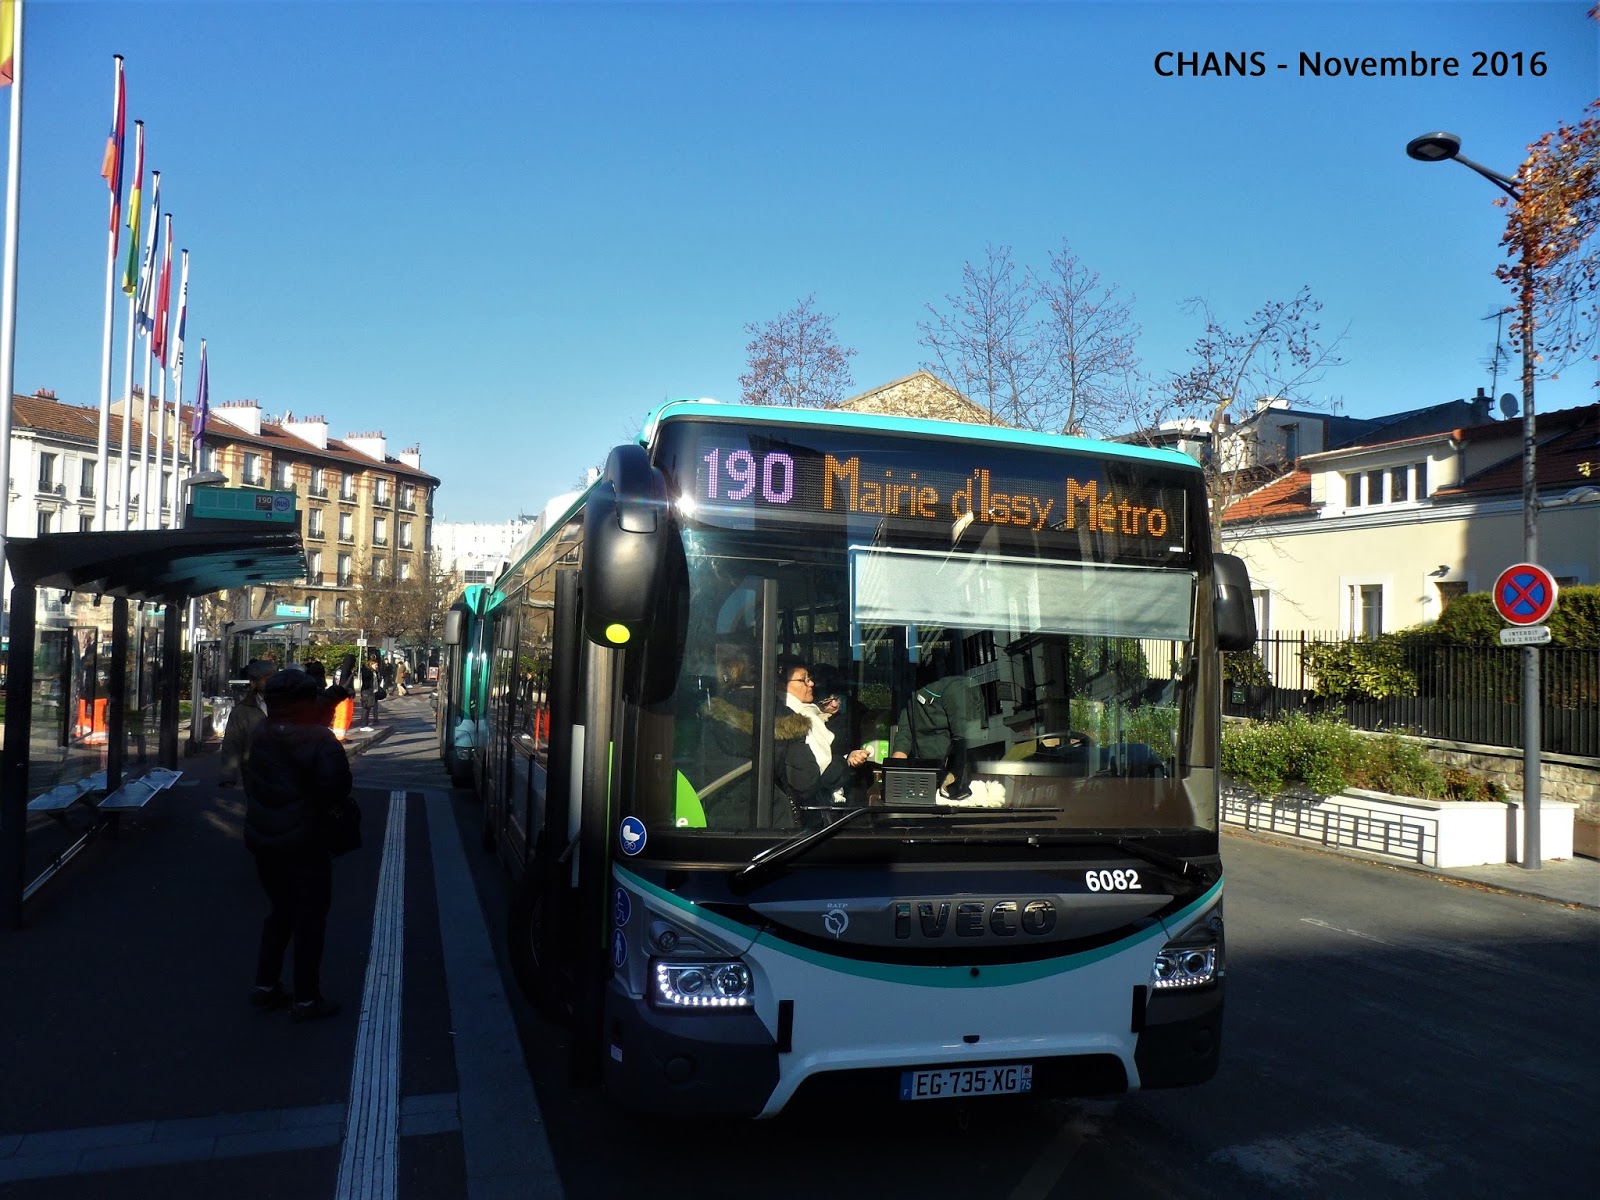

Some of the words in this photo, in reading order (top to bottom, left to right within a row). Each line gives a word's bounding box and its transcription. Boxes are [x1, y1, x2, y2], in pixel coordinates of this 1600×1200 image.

[703, 447, 794, 504] 190
[825, 455, 938, 518] Mairie
[952, 470, 1053, 531] d'Issy
[1066, 478, 1167, 537] Métro
[1085, 869, 1142, 892] 6082
[895, 899, 1057, 940] IVECO
[916, 1068, 1017, 1096] EG-735-XG
[1021, 1078, 1032, 1090] 75
